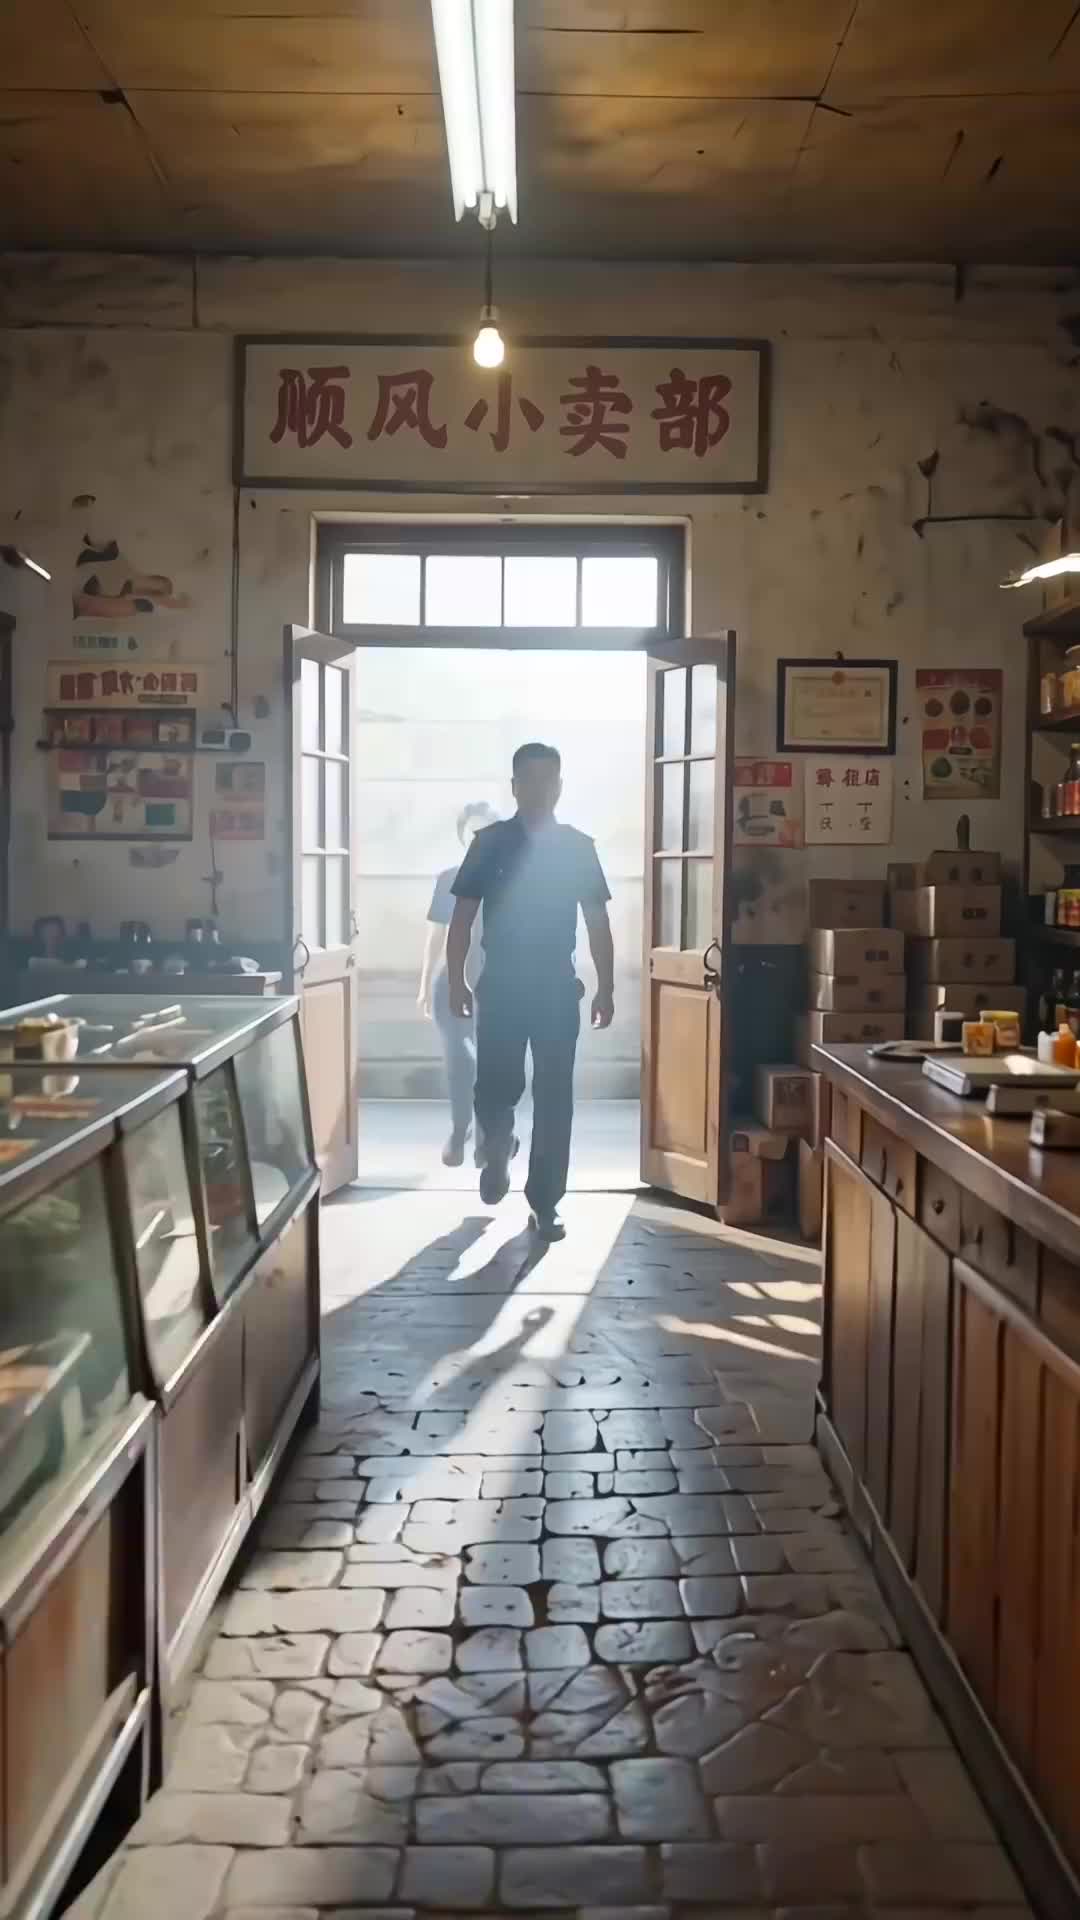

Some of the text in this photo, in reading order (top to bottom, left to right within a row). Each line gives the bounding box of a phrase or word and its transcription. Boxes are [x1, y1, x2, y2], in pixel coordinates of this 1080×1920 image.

[269, 365, 732, 459] 顺风小卖部
